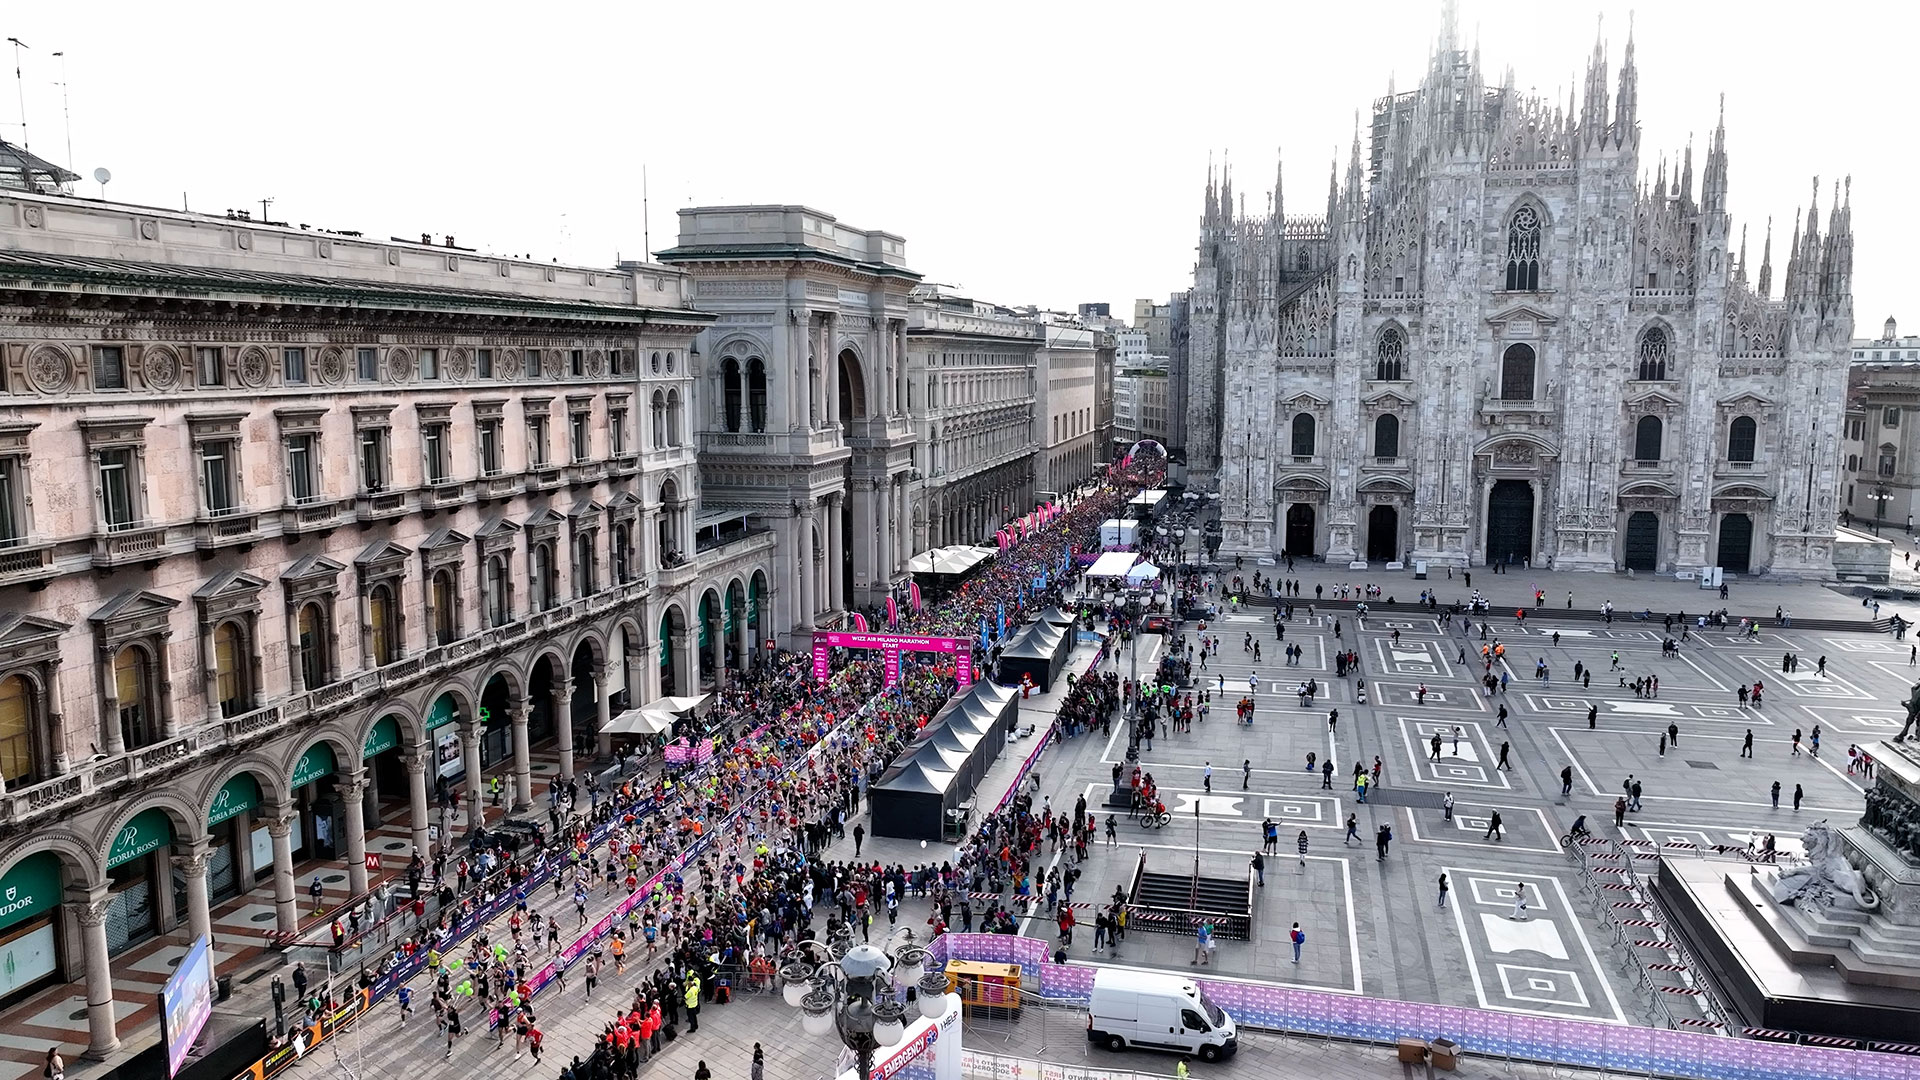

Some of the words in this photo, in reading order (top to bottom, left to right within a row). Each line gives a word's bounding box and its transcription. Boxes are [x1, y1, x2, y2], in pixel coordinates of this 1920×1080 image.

[229, 801, 248, 815] ROSSI
[137, 838, 159, 854] ROSSI
[367, 856, 379, 867] M
[0, 896, 33, 916] UDOR
[943, 1010, 958, 1029] HELP
[883, 1036, 925, 1078] EMERGENCY
